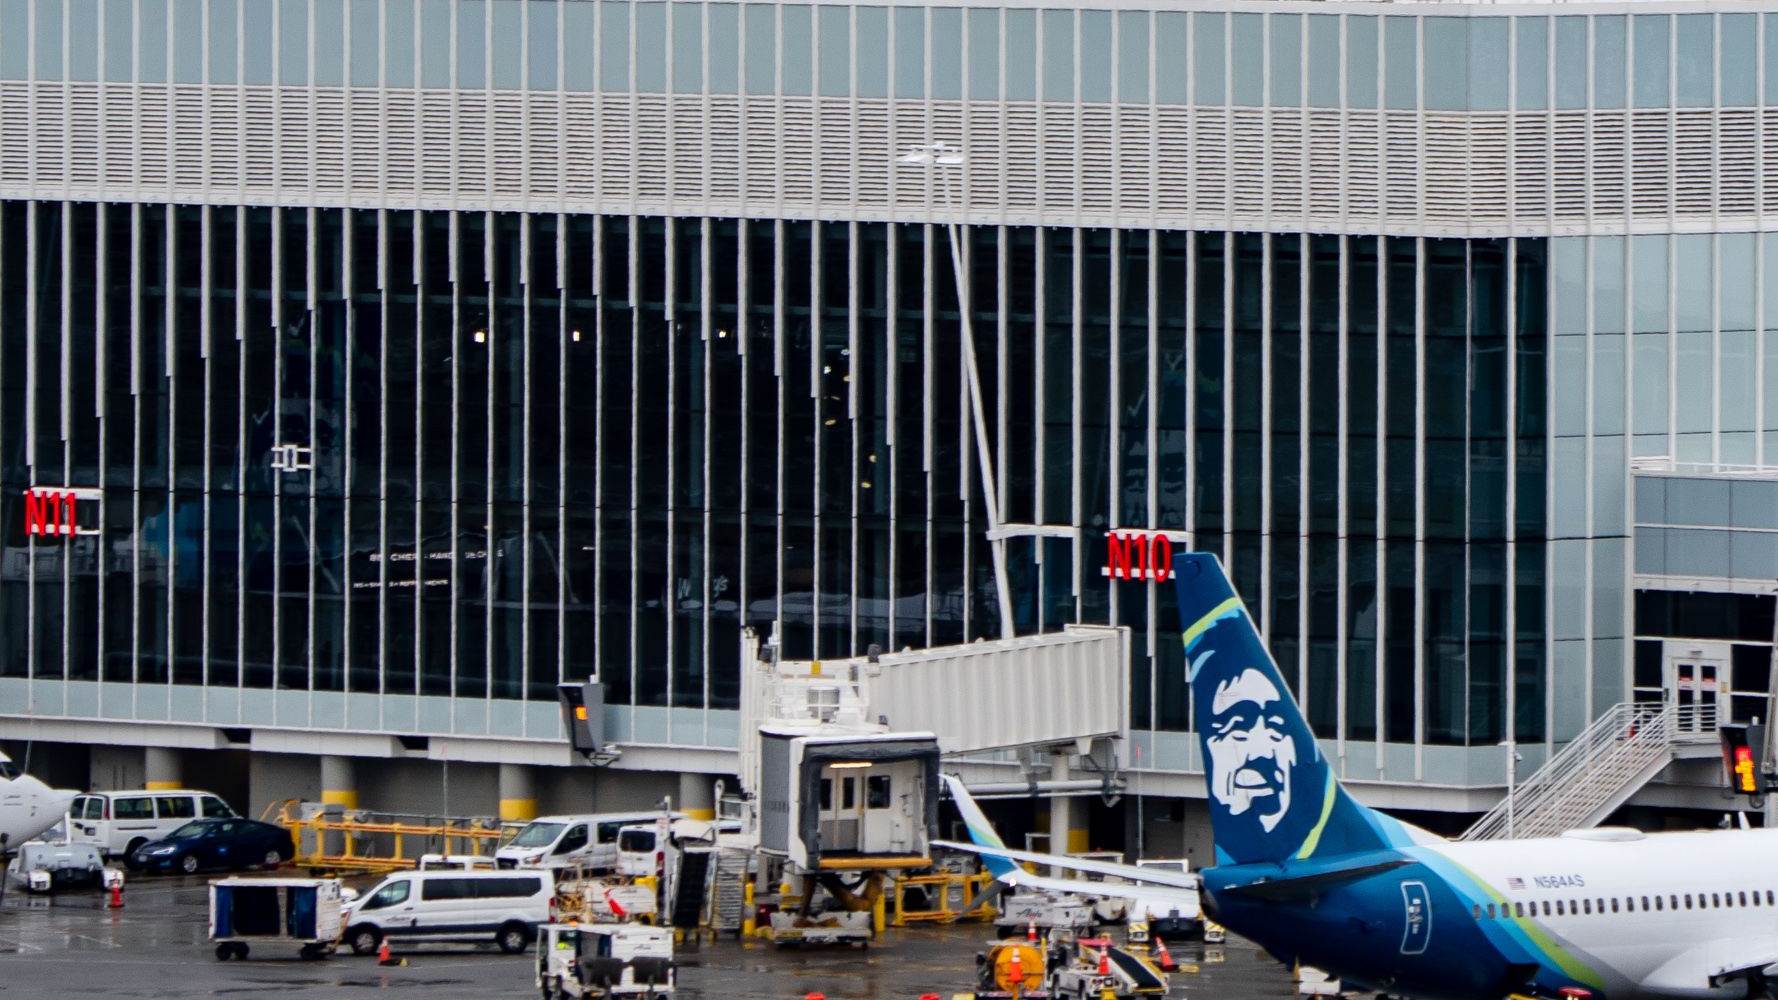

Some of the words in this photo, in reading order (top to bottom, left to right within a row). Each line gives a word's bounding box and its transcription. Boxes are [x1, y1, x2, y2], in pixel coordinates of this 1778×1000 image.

[25, 489, 76, 537] N11
[1108, 532, 1172, 582] N10
[1533, 874, 1585, 888] N564AS
